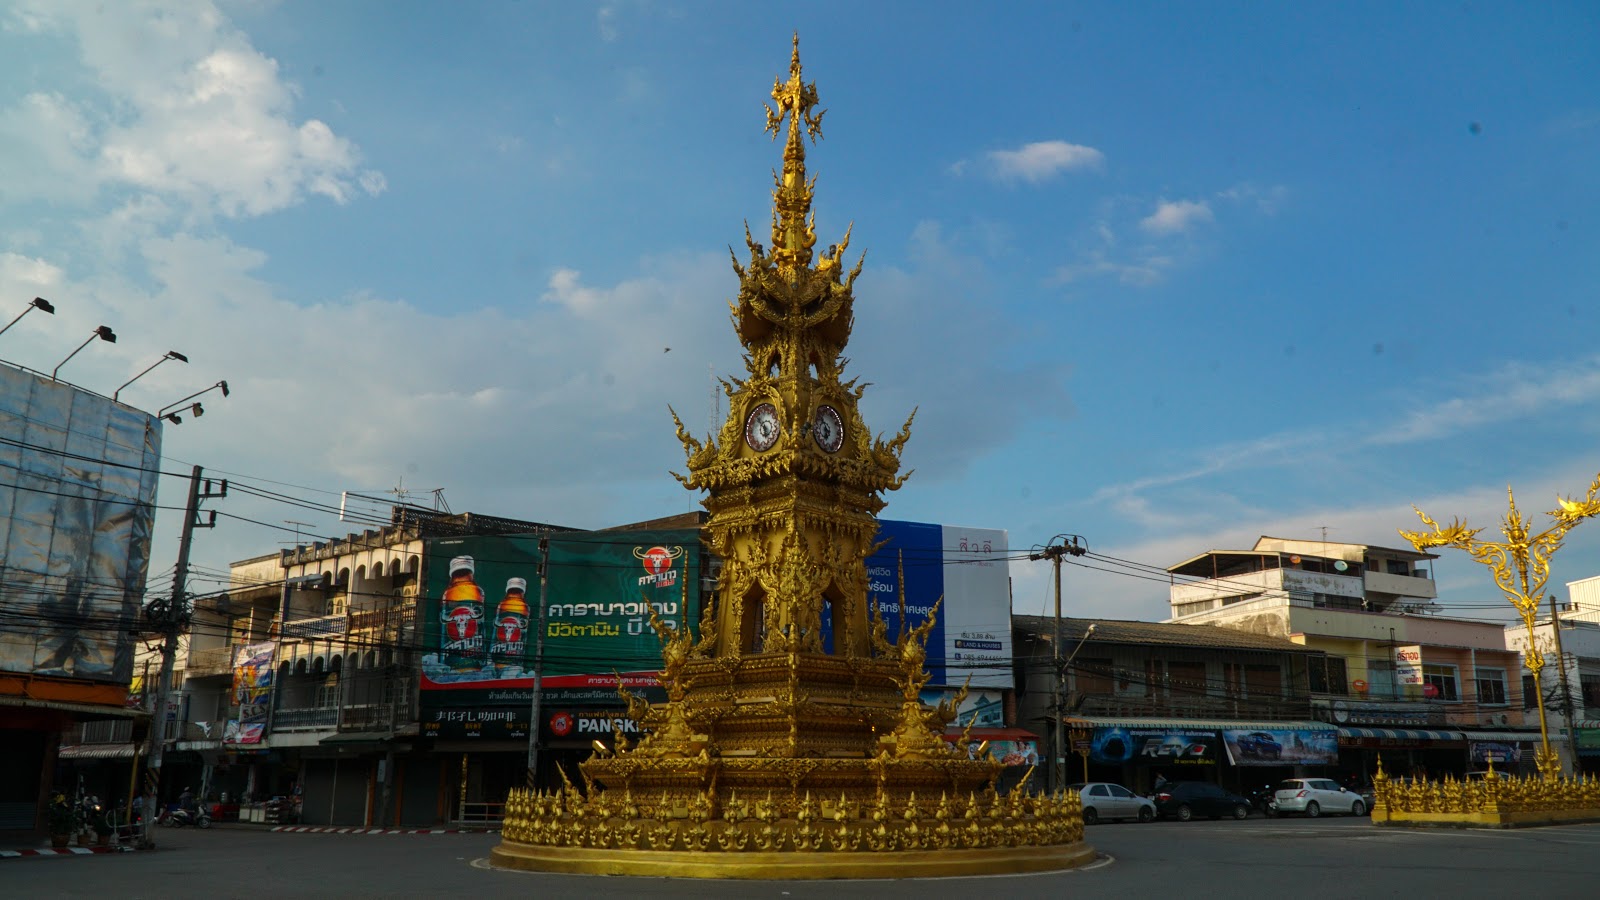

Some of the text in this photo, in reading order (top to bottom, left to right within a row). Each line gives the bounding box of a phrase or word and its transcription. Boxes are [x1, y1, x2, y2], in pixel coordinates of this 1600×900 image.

[638, 569, 677, 586] คาราบาว
[549, 602, 677, 617] คาราบาวแดง
[547, 622, 619, 637] มีวิตามิน
[627, 617, 643, 635] บี
[488, 690, 534, 700] ห้ามดื่มเกินวันล
[1141, 738, 1208, 758] REVO
